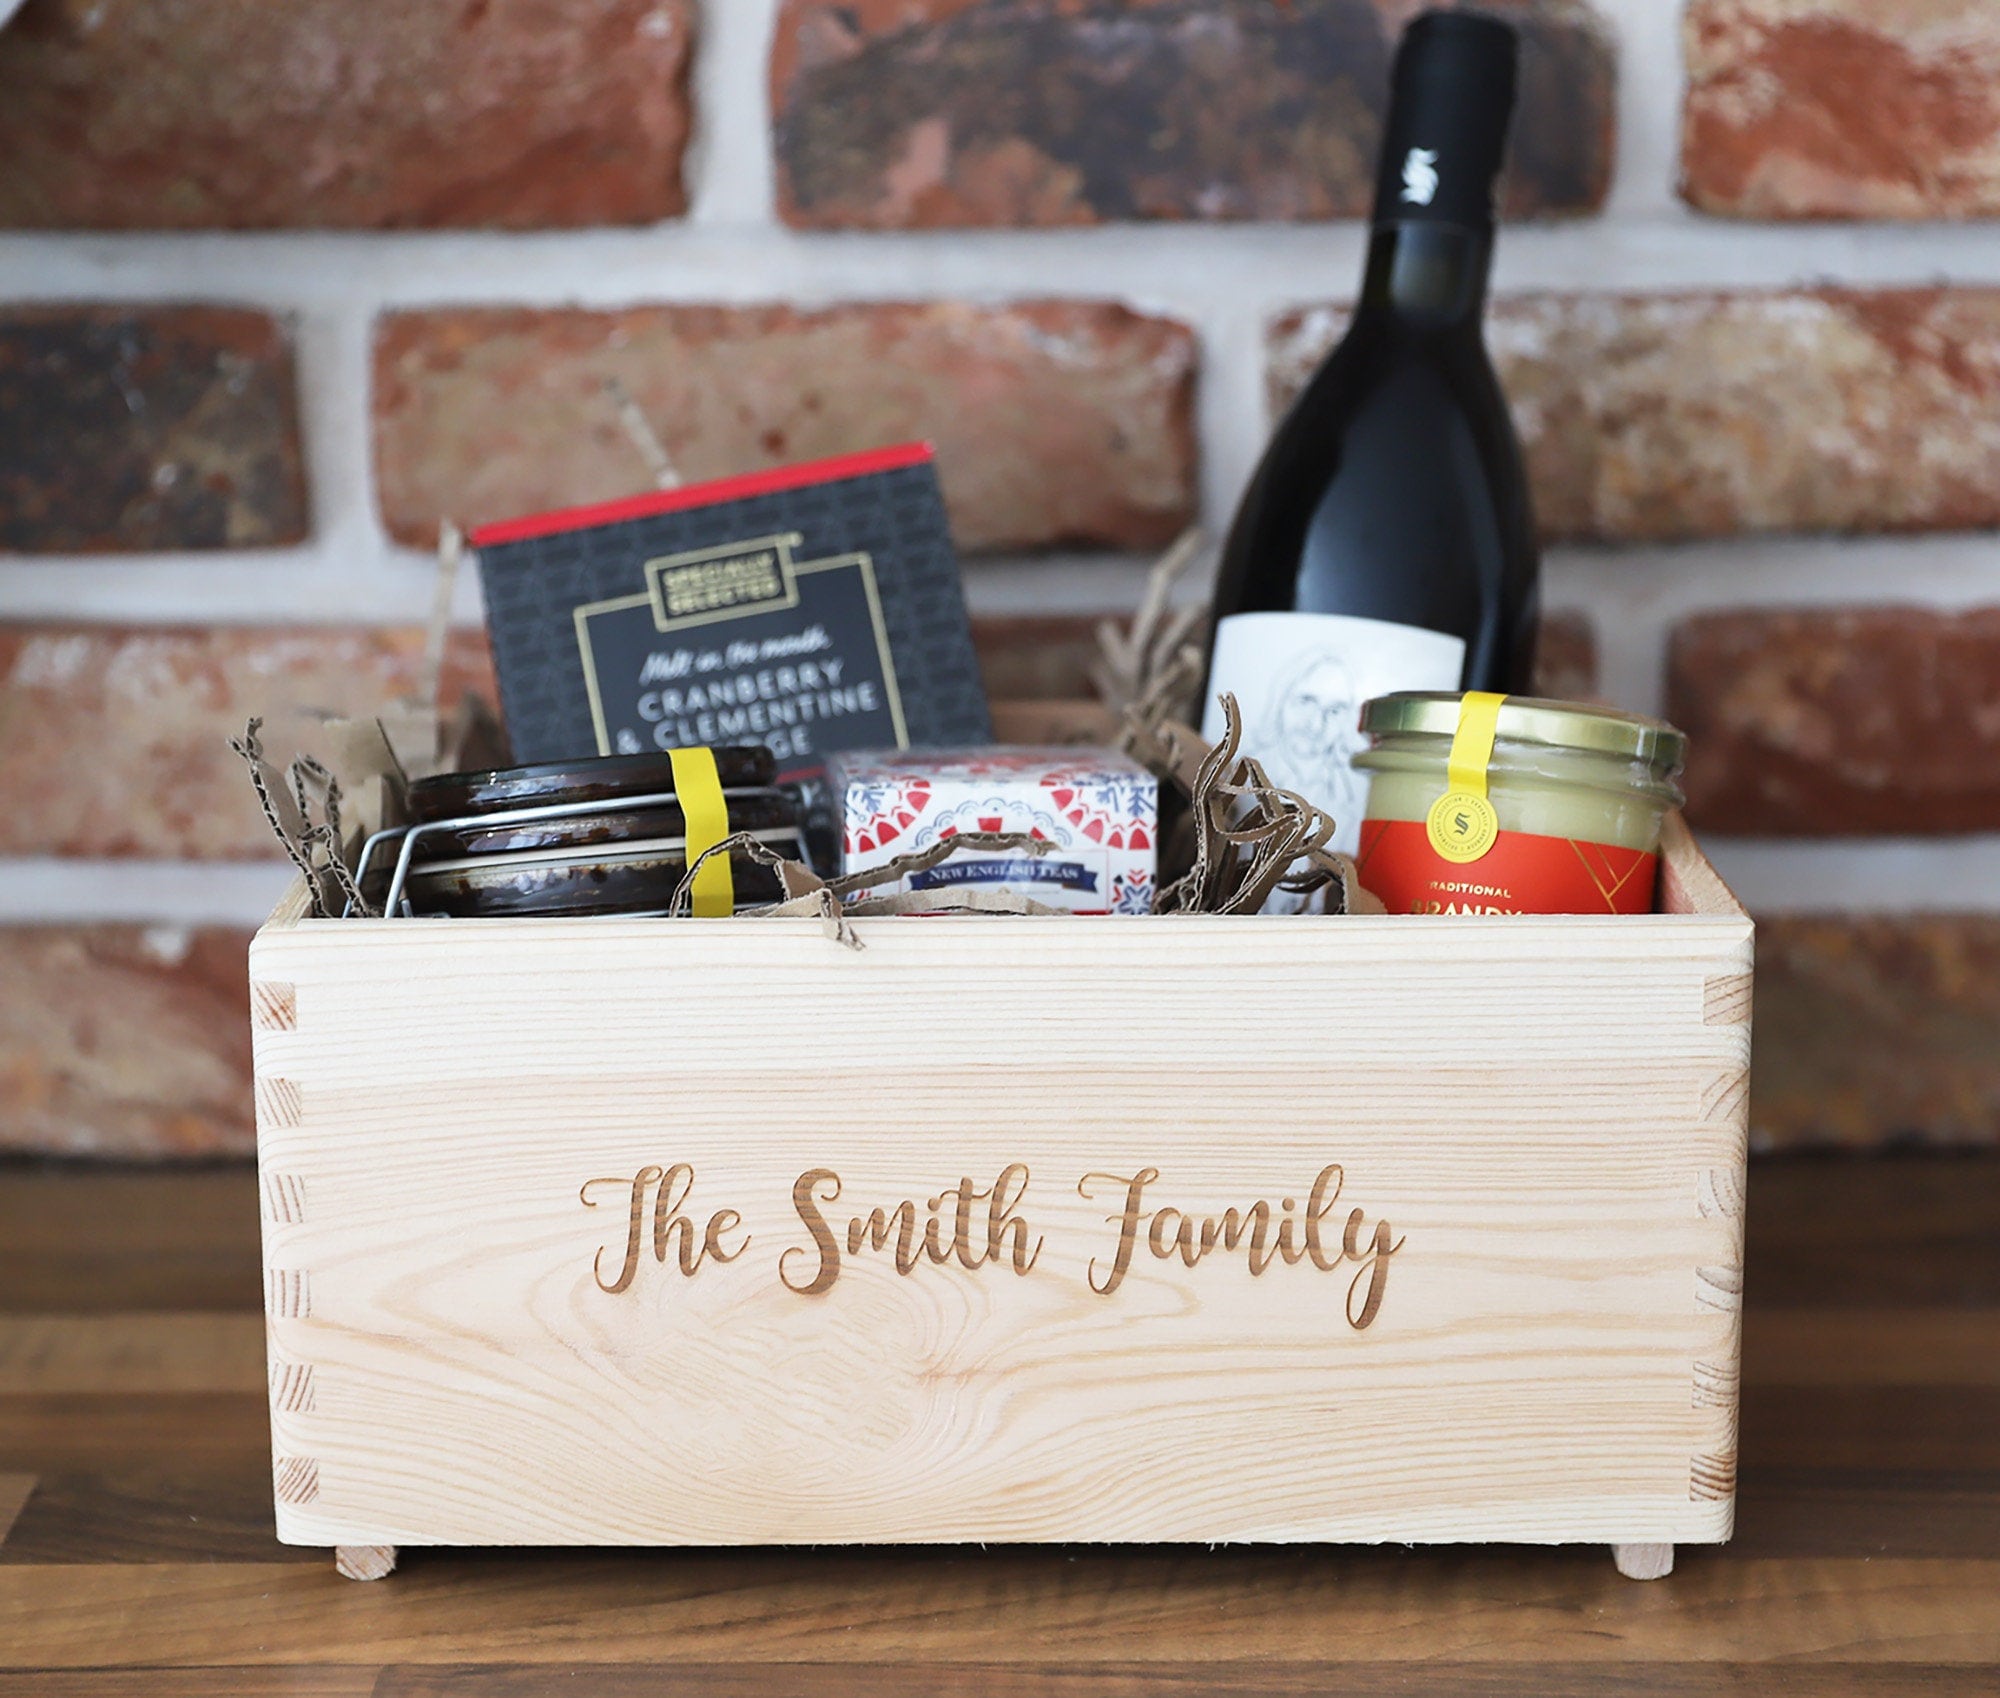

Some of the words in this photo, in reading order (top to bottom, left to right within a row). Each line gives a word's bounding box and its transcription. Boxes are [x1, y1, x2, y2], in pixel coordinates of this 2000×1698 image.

[636, 656, 845, 722] CRANBERRY
[616, 726, 642, 755] &
[653, 679, 881, 750] CLEMENTINE
[1453, 811, 1472, 836] S
[928, 867, 966, 882] NEW
[965, 863, 1036, 879] ENGLISH
[1036, 864, 1080, 879] TEAS
[1425, 879, 1512, 899] RADITIONAL
[579, 1162, 752, 1295] The
[778, 1162, 1045, 1296] Smith
[1077, 1163, 1406, 1330] Family
